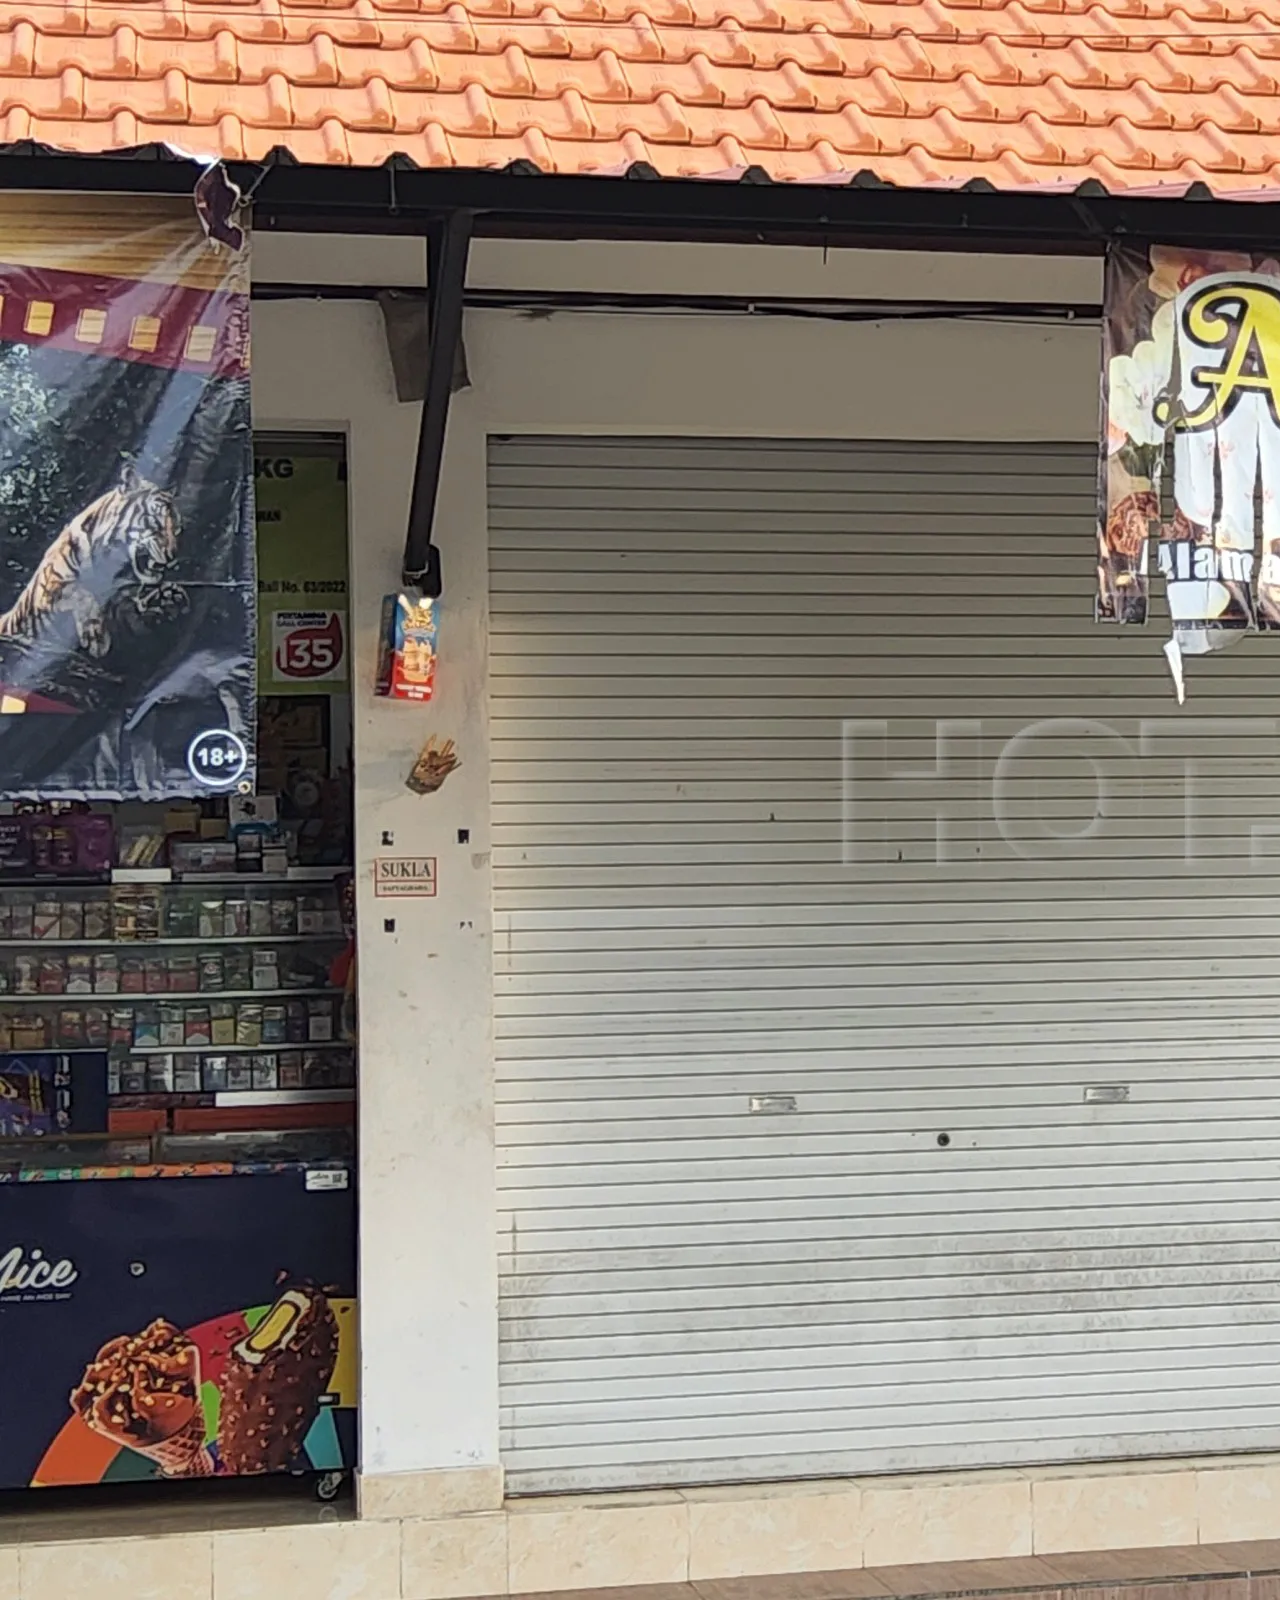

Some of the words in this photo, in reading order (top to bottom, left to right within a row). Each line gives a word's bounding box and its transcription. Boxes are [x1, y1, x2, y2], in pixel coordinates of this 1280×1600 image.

[278, 639, 333, 669] 135
[197, 747, 238, 766] 18+
[381, 861, 431, 877] SUKLA
